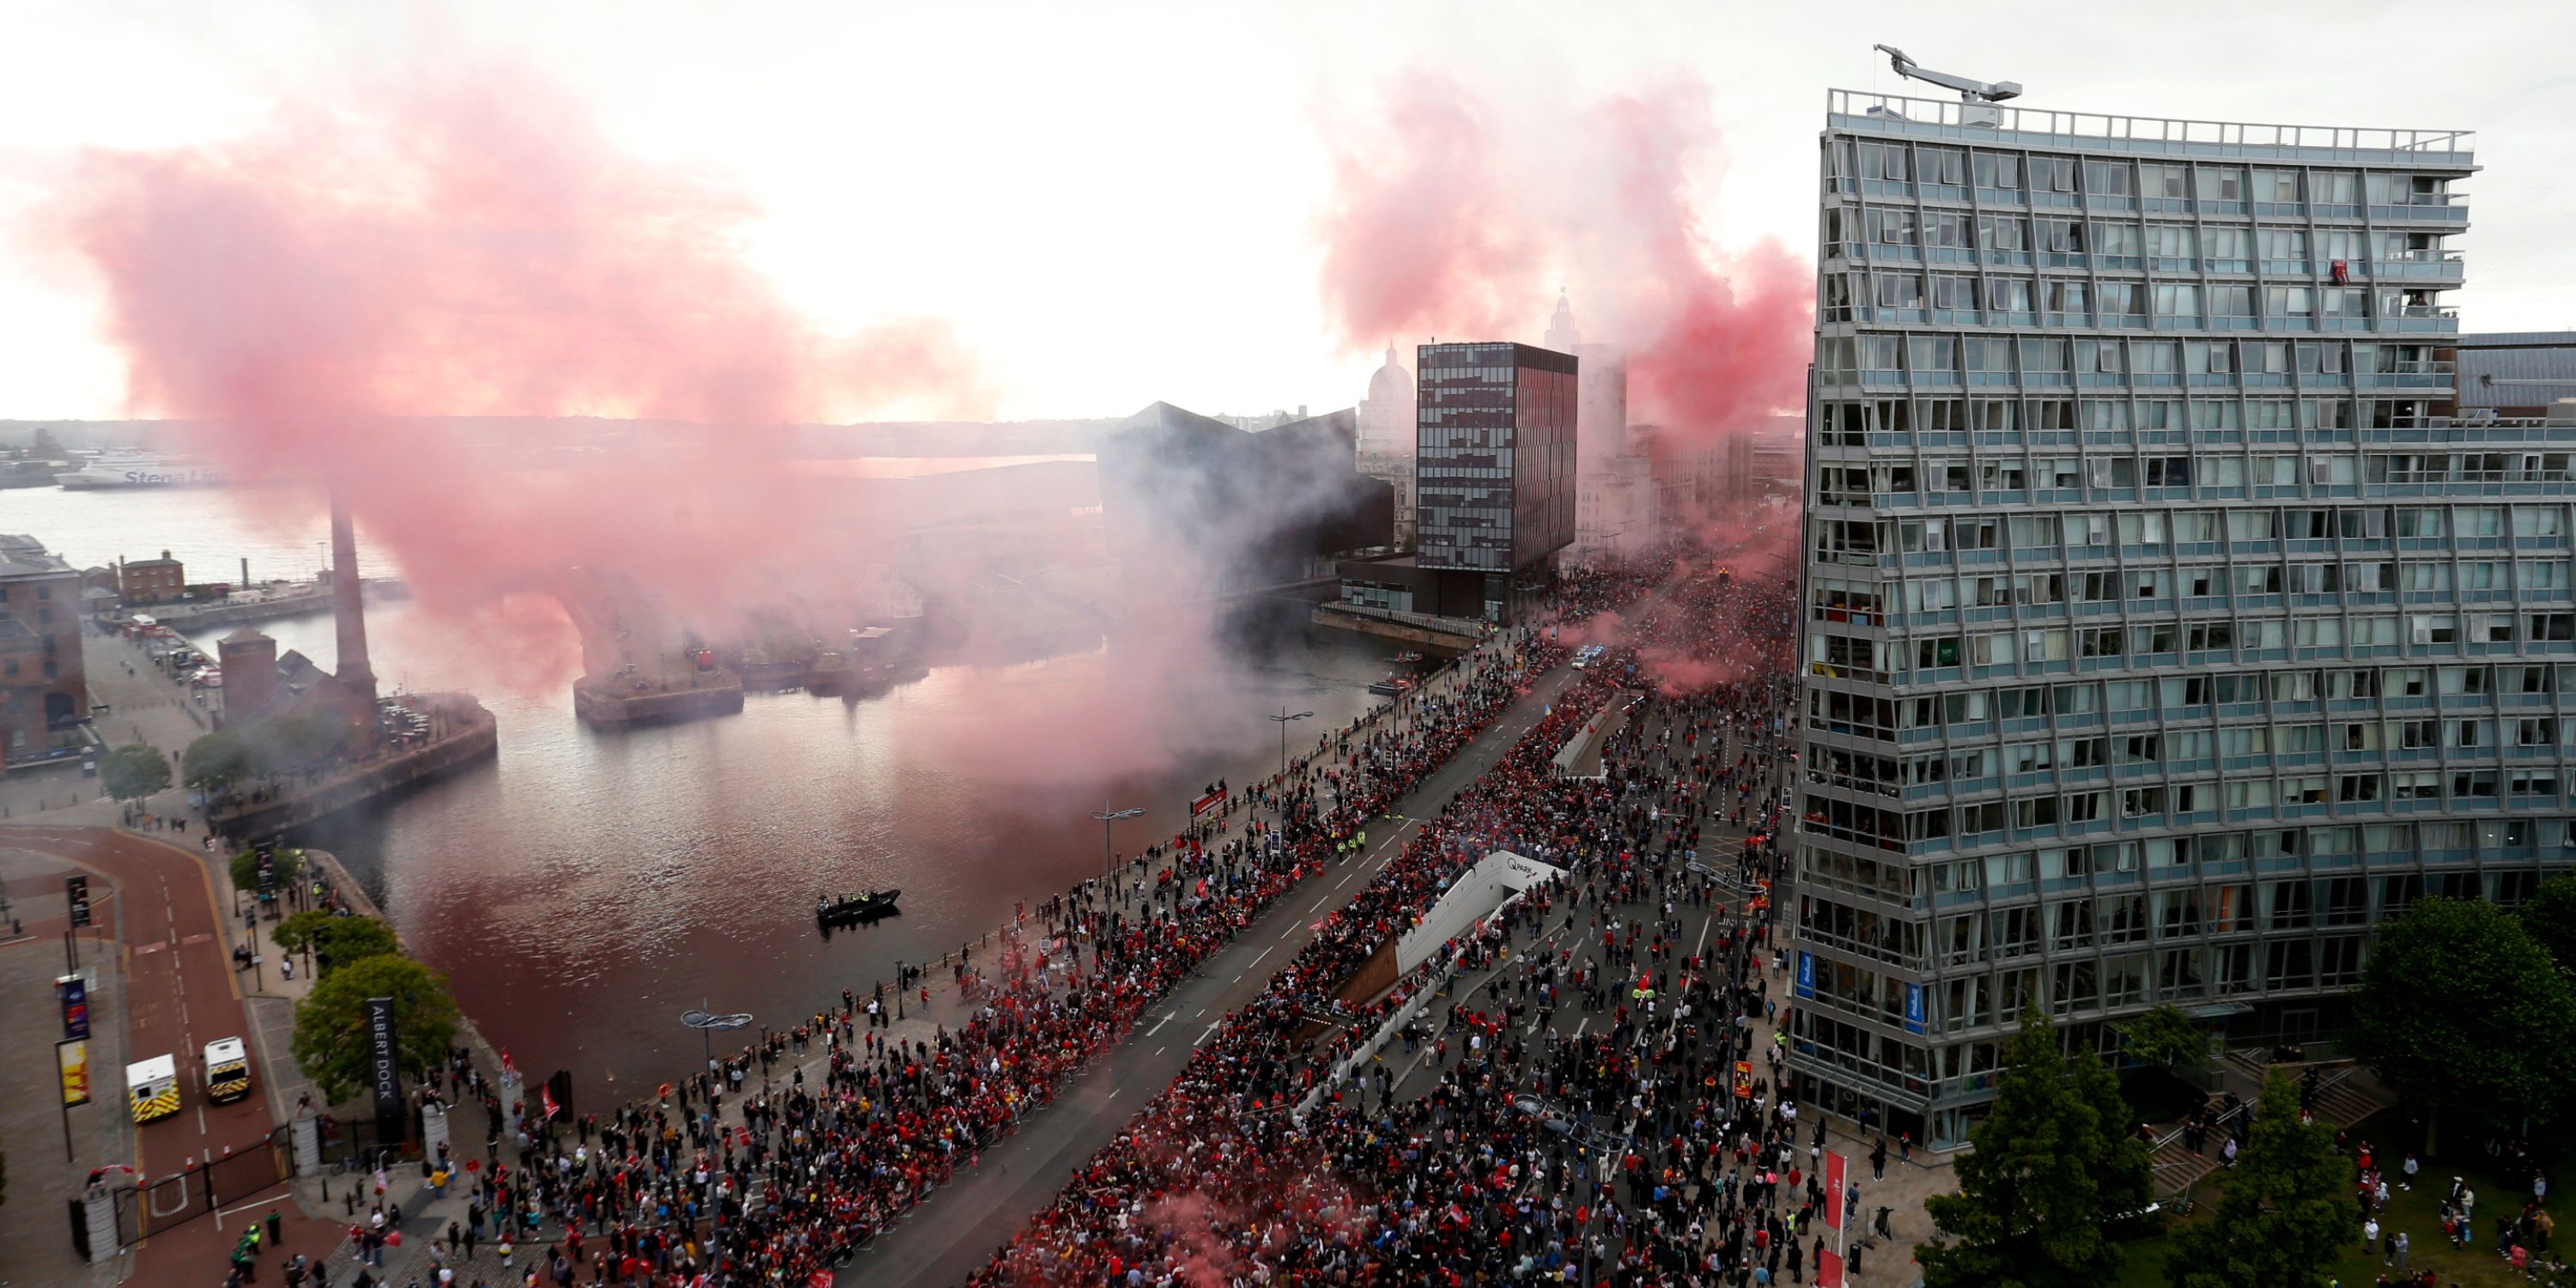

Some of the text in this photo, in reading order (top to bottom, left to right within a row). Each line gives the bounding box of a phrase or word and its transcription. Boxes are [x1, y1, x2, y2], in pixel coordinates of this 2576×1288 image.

[125, 471, 185, 483] Stena
[372, 1005, 392, 1100] ALBERT DOCK
